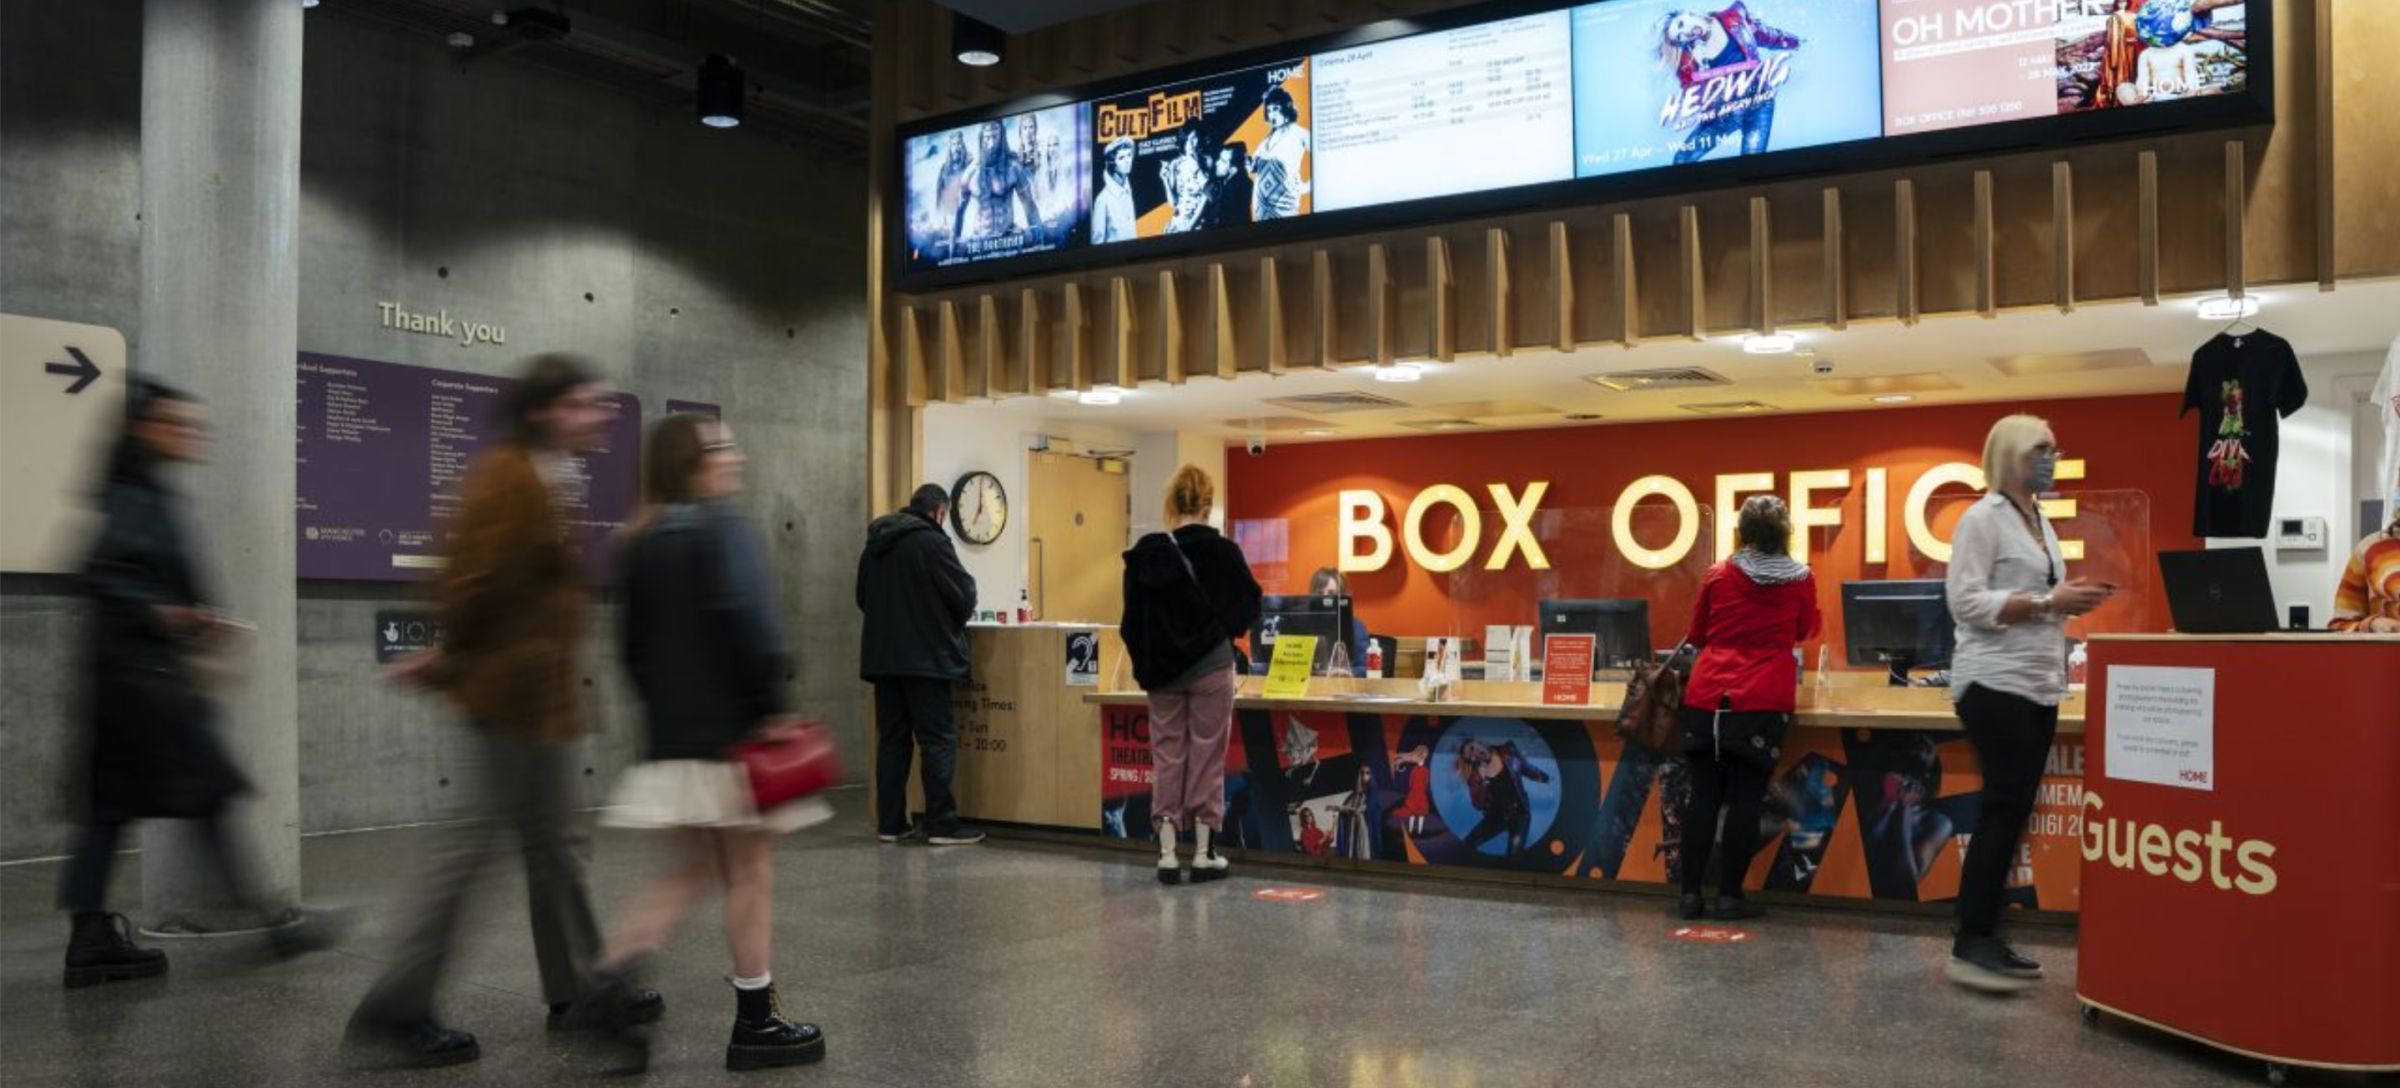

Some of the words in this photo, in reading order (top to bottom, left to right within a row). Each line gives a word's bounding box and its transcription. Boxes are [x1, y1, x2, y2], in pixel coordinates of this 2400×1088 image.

[1892, 14, 1944, 46] OH
[1956, 0, 2104, 36] MOTHER
[1267, 65, 1305, 84] HOME
[1660, 53, 1790, 126] HEDWIG
[2144, 73, 2206, 96] HOME
[1100, 111, 1148, 137] CULT
[1151, 96, 1200, 127] FILM
[1666, 136, 1696, 152] Wed
[379, 302, 455, 337] Thank
[460, 319, 505, 346] you
[1338, 480, 1550, 573] BOX
[1109, 712, 1151, 742] HO
[2044, 745, 2085, 775] ALE
[2179, 768, 2208, 784] HOME
[2080, 790, 2279, 896] Guests
